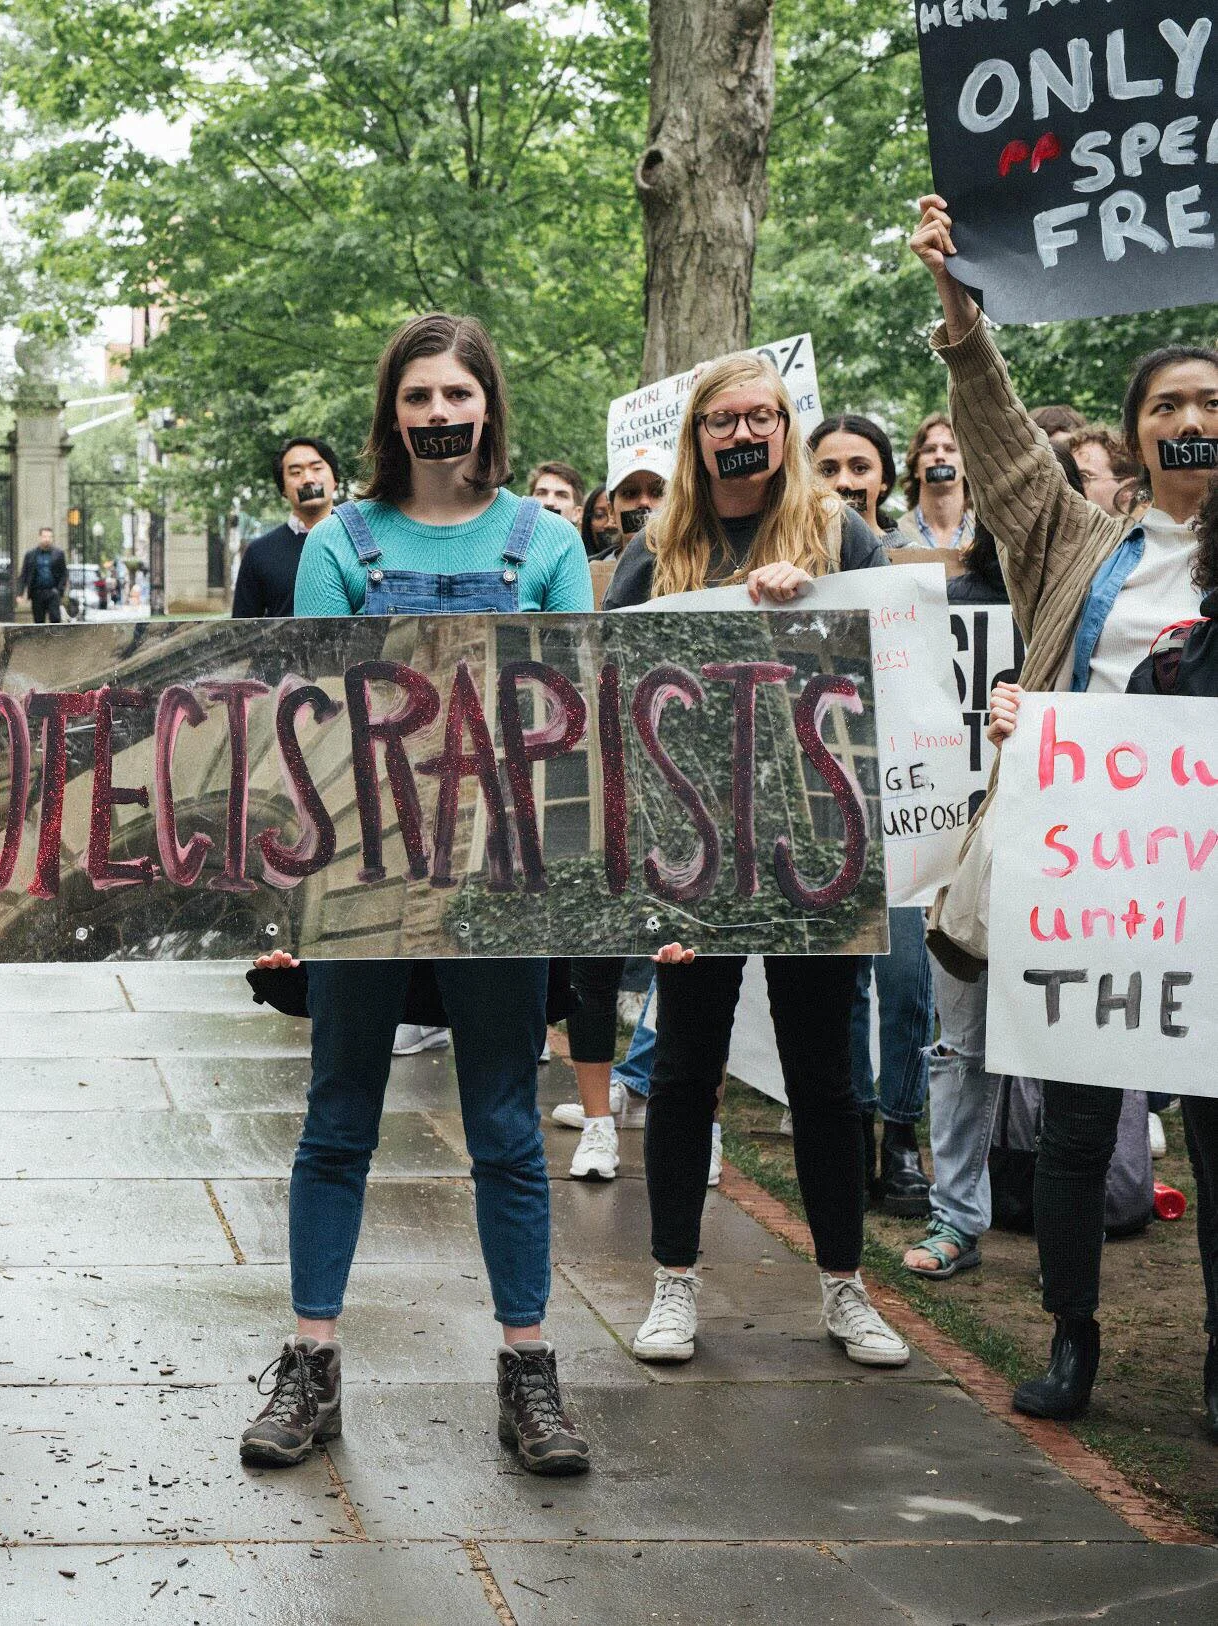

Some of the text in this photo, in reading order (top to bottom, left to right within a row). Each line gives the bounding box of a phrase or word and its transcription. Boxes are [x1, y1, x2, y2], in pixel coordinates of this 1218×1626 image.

[958, 17, 1212, 133] ONLY
[913, 731, 963, 750] know
[344, 659, 868, 911] RAPISTS
[1030, 896, 1186, 944] until
[1023, 968, 1193, 1038] THE
